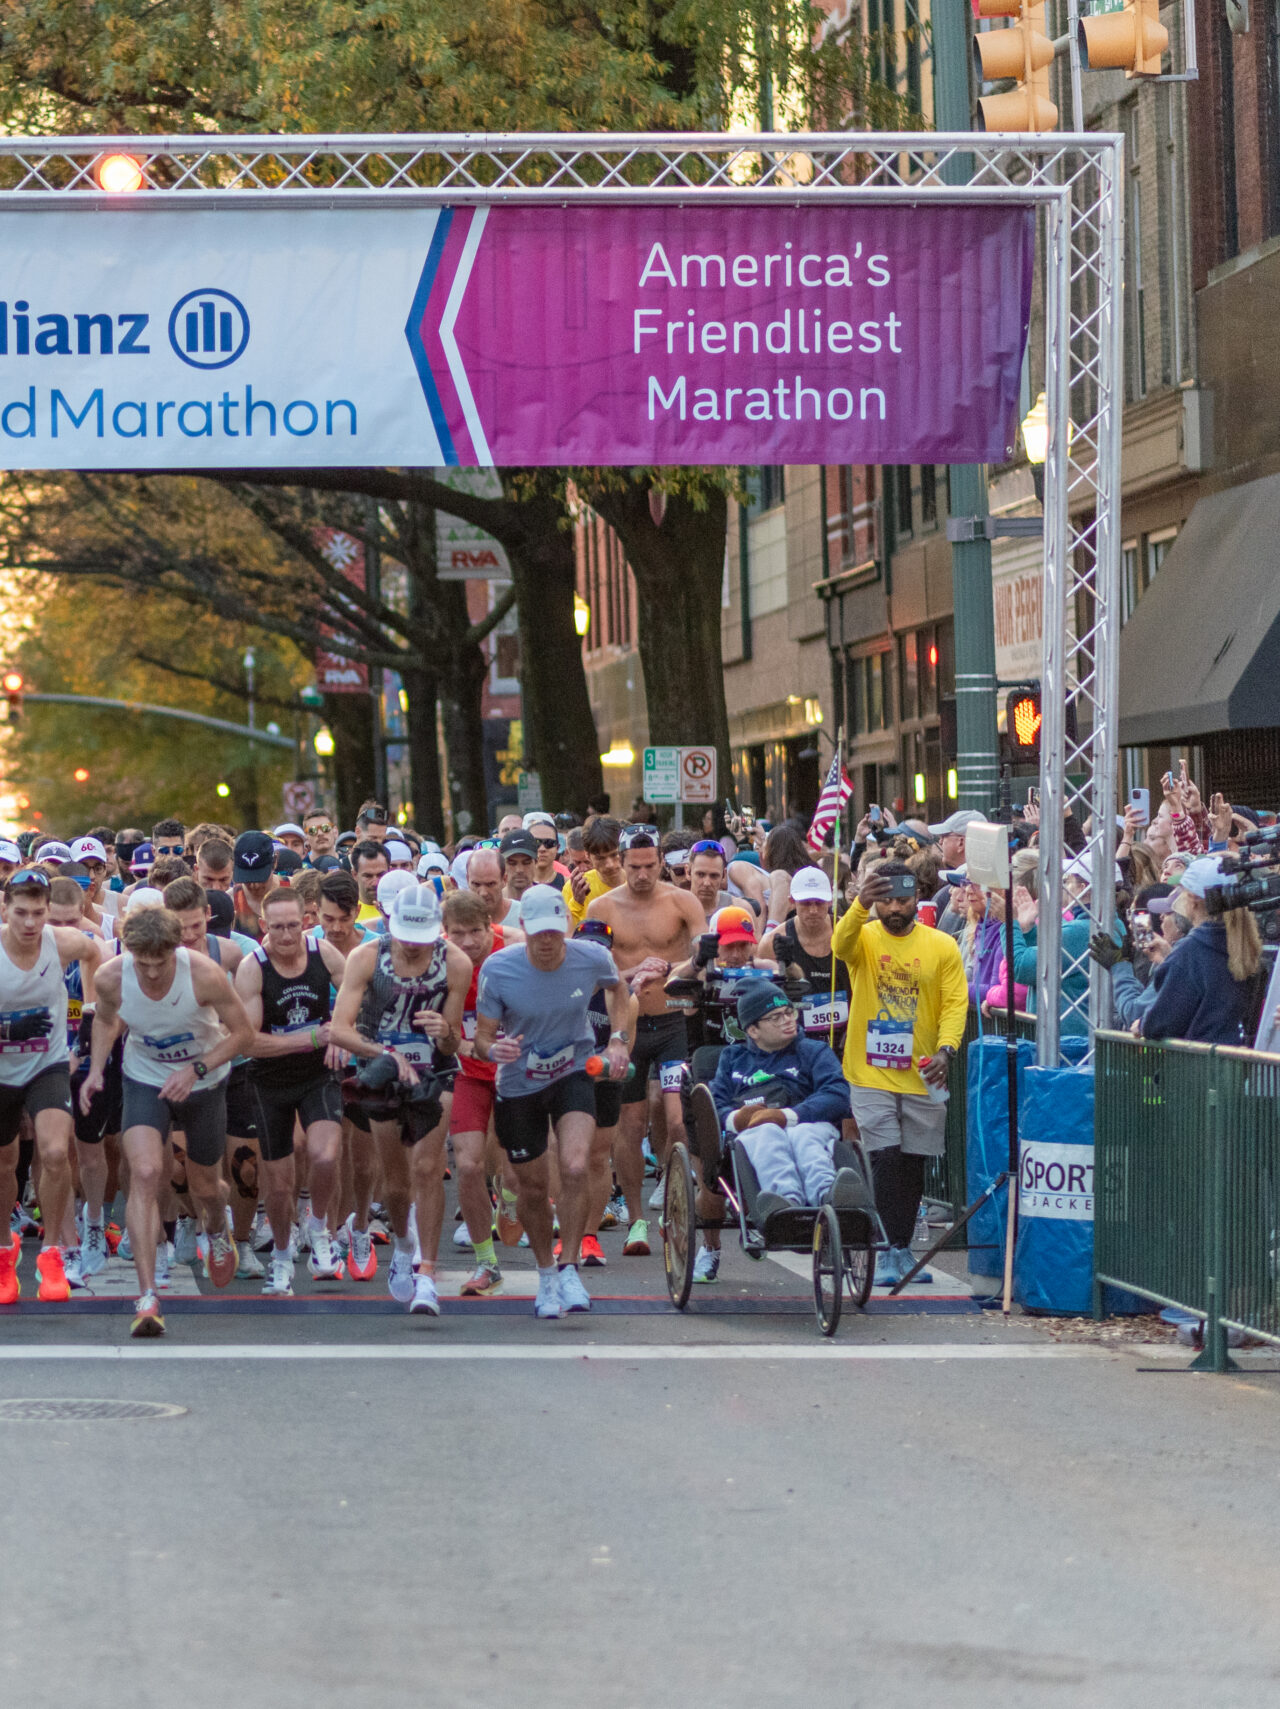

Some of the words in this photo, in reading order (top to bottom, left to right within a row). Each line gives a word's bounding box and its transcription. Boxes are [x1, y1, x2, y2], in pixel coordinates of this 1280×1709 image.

[638, 241, 891, 287] America's
[633, 308, 902, 354] Friendliest
[647, 375, 887, 420] Marathon
[452, 550, 499, 567] RVA
[646, 752, 654, 767] 3
[812, 1011, 841, 1025] 3509
[875, 1041, 905, 1055] 1324
[535, 1055, 566, 1071] 2109
